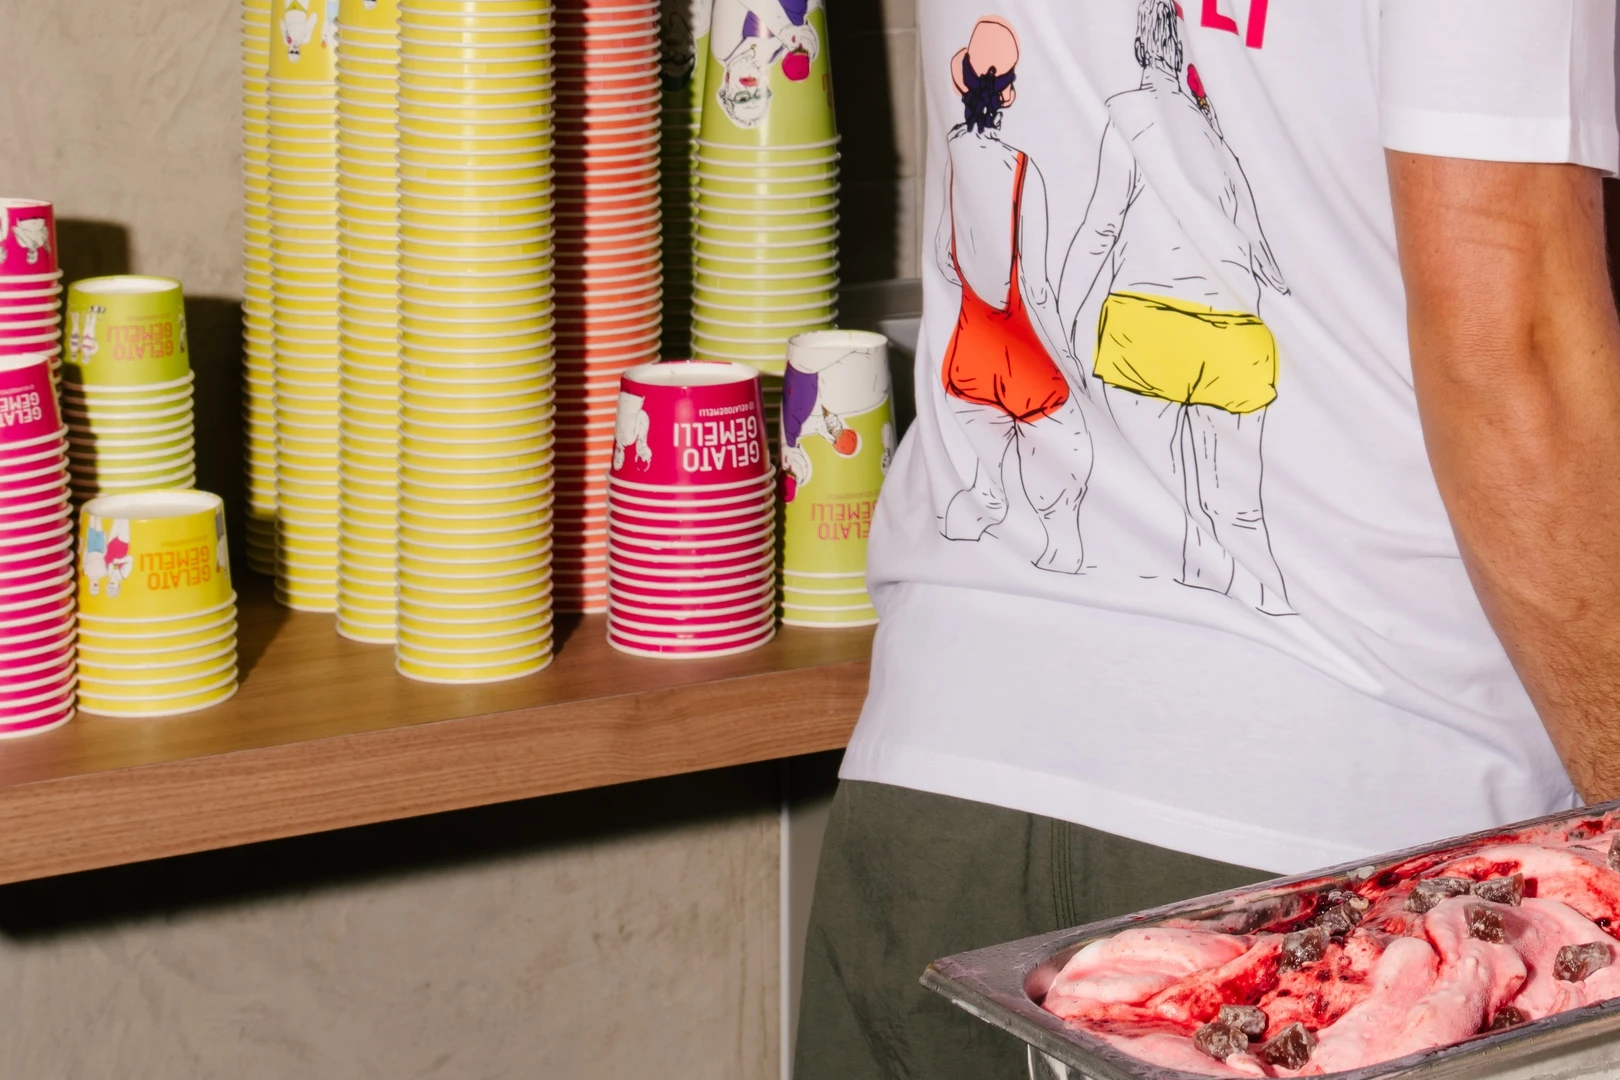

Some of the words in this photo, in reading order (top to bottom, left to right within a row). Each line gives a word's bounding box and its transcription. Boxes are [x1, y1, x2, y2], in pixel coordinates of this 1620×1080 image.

[106, 322, 172, 343] GEMELLI
[113, 339, 173, 360] GELATO
[0, 392, 40, 412] GEME
[0, 406, 42, 427] GELA
[673, 416, 758, 447] GEMELLI
[683, 440, 759, 472] GELATO
[818, 521, 871, 541] ELATO
[139, 545, 209, 572] GEMELLI
[147, 564, 211, 590] GELATO
